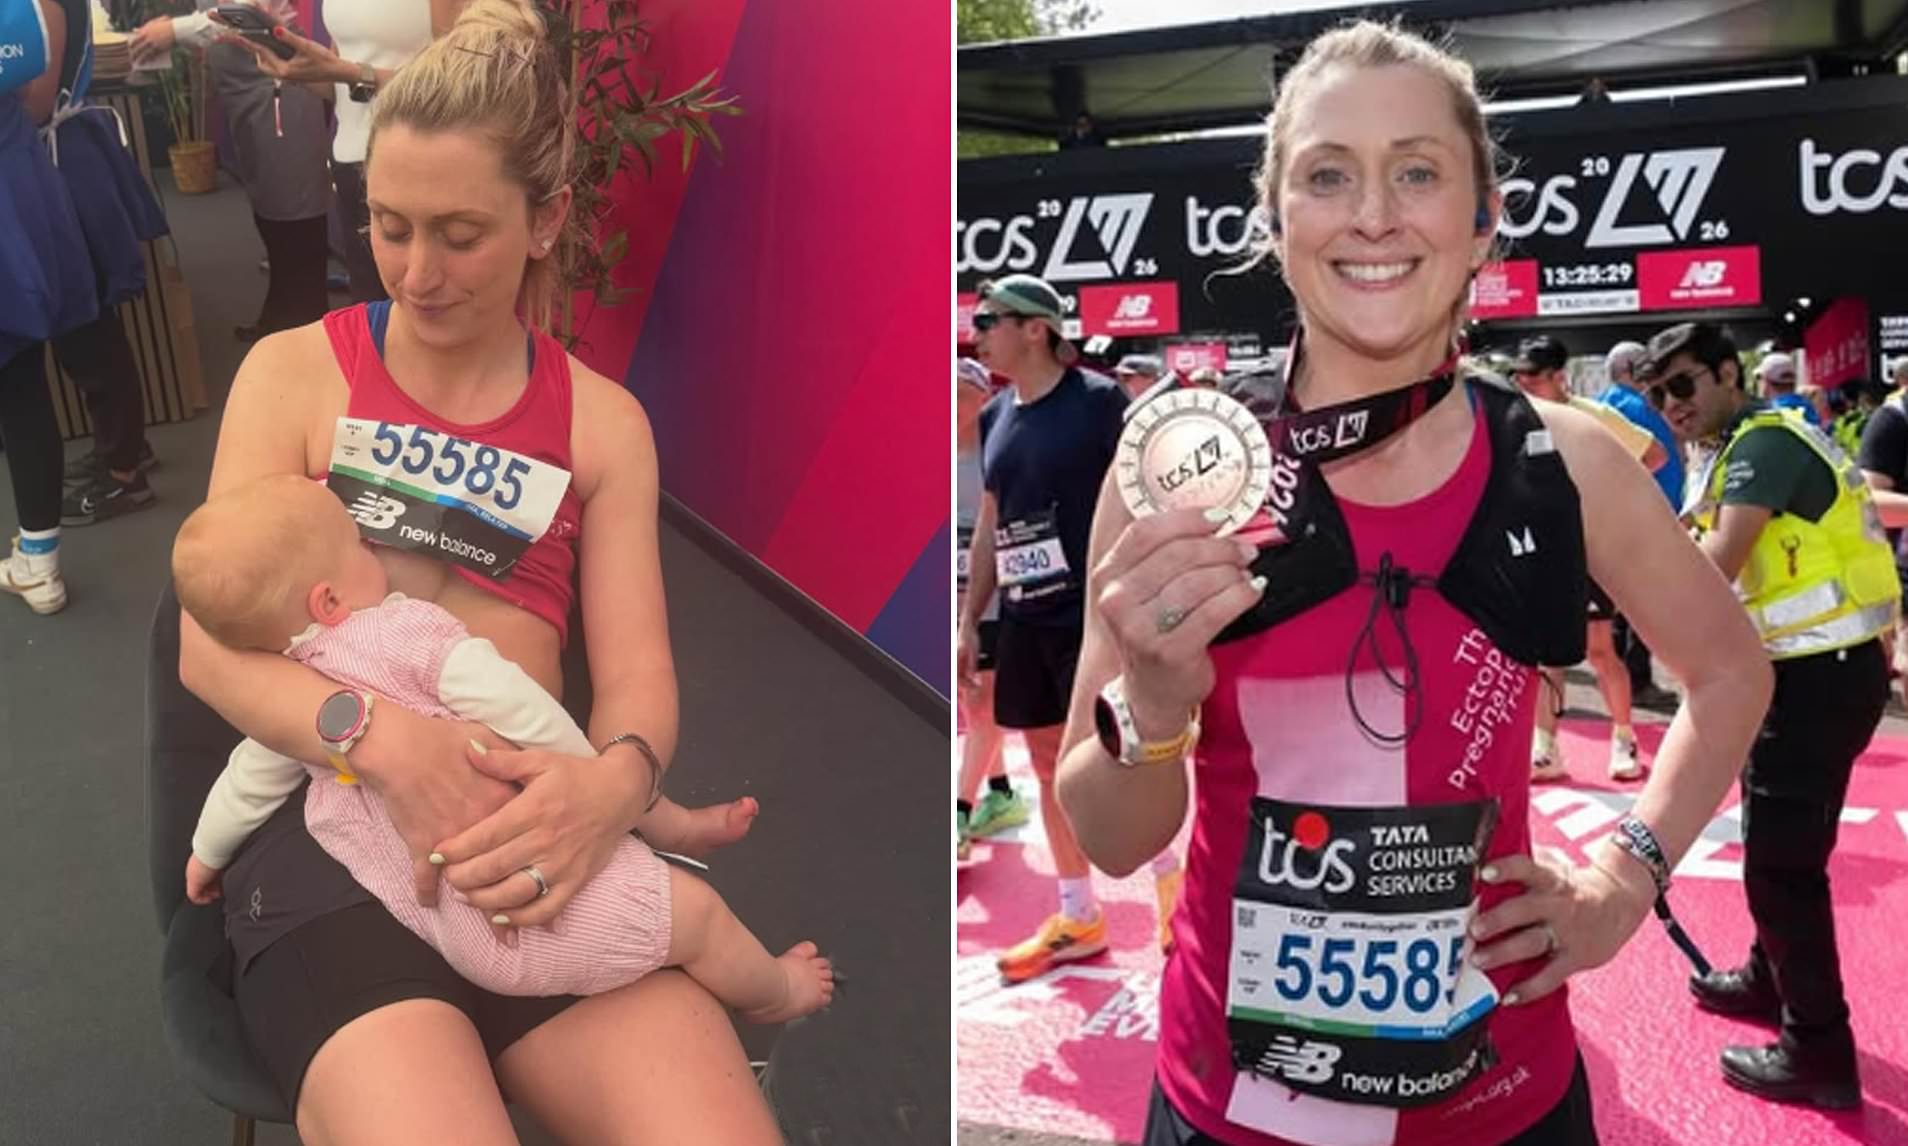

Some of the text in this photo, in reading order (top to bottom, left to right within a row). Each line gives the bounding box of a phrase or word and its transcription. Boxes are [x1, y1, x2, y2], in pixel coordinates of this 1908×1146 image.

[1499, 174, 1579, 238] cs
[1581, 157, 1609, 176] 20
[1700, 221, 1729, 240] 26
[957, 215, 1037, 272] cs
[1037, 199, 1061, 217] 20
[1133, 258, 1158, 275] 26
[1543, 263, 1633, 286] 13:25:29
[1290, 425, 1332, 454] tcs
[371, 420, 531, 511] 55585
[1157, 463, 1194, 492] tcs
[400, 524, 497, 566] new balance
[1454, 628, 1488, 666] Th
[1450, 648, 1502, 734] Ectop
[1499, 662, 1531, 724] Tru
[1448, 657, 1518, 791] Pregnanc
[1369, 825, 1430, 846] TATA
[1366, 870, 1457, 896] SERVICES
[1341, 1072, 1394, 1094] new
